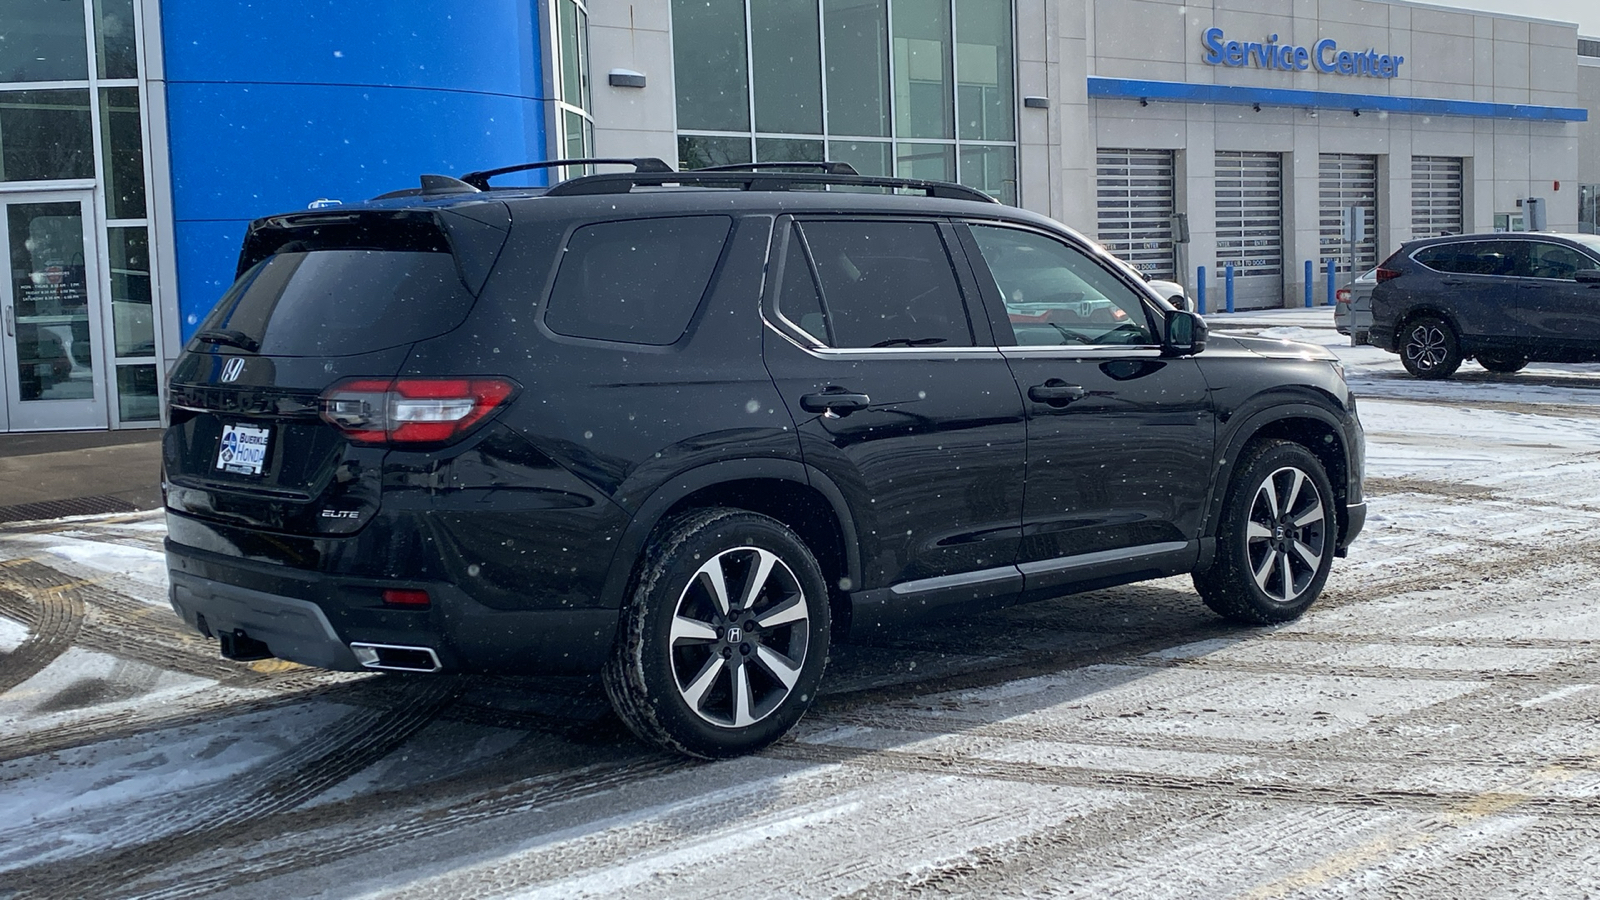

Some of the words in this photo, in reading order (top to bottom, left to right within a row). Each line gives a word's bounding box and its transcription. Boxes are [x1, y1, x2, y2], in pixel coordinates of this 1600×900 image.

[1204, 27, 1309, 71] Service
[1313, 38, 1405, 79] Center
[239, 432, 268, 446] BUERKLE
[235, 444, 264, 463] HONDA
[321, 509, 360, 519] ELITE
